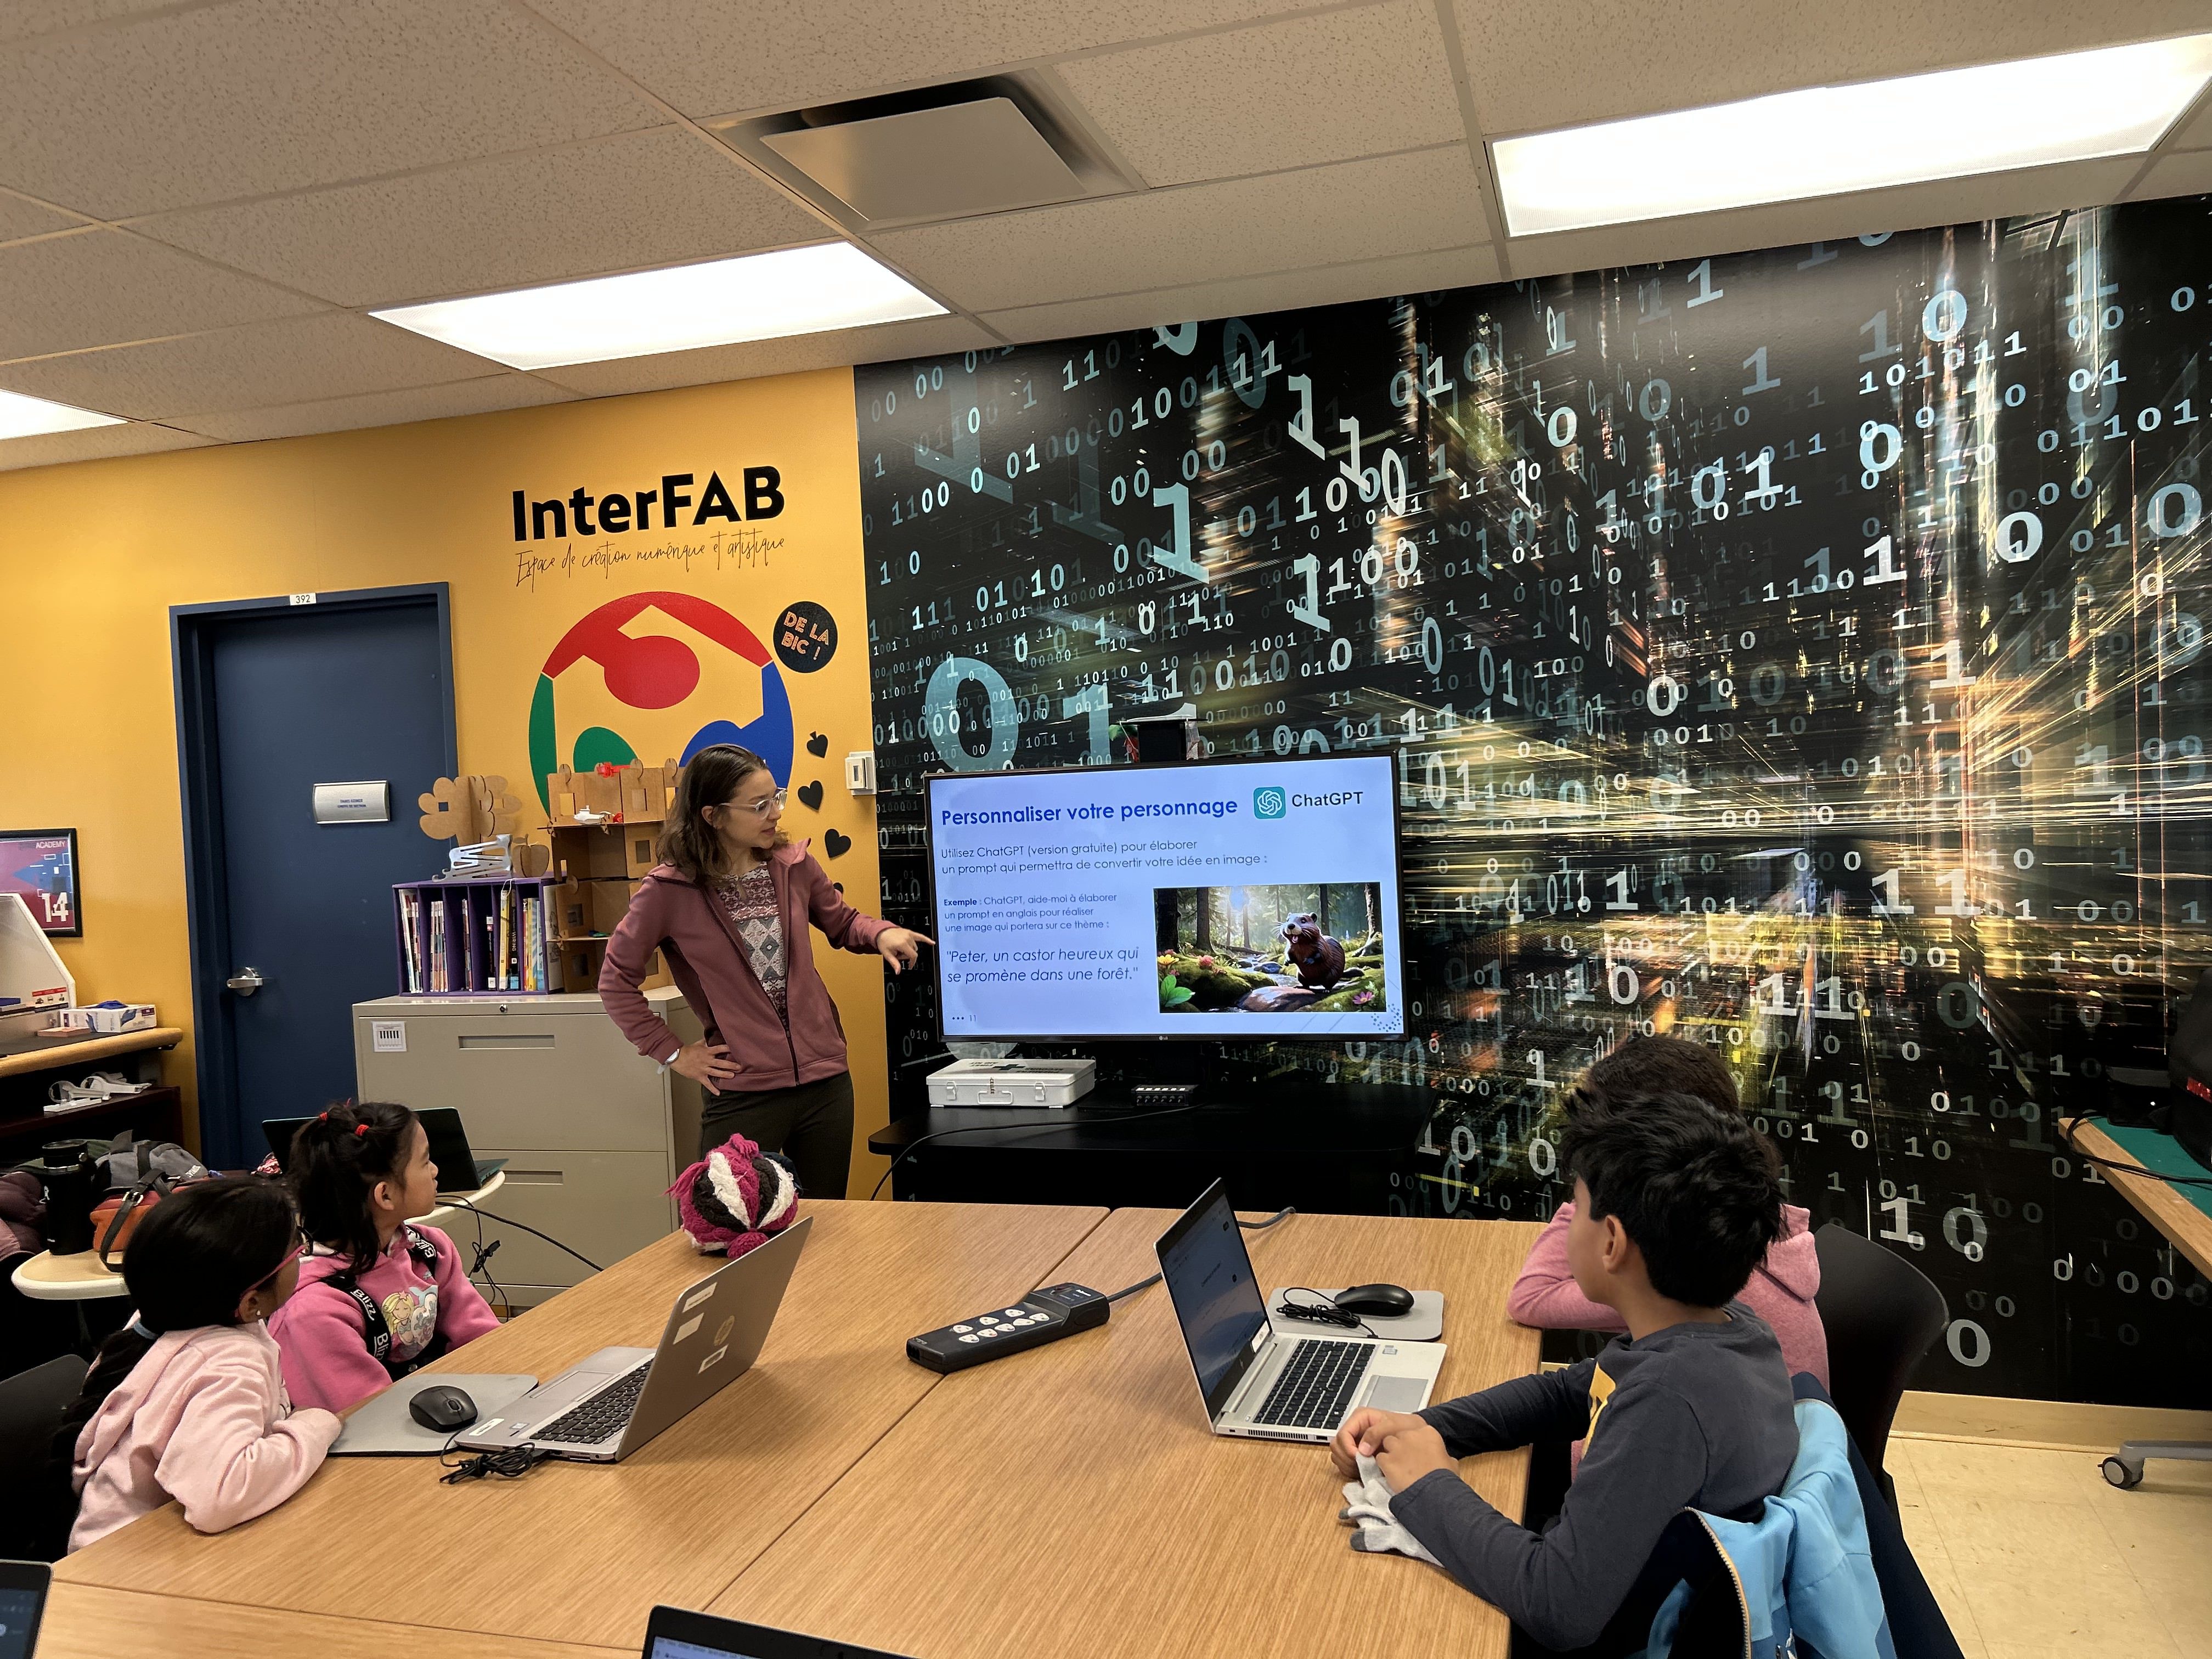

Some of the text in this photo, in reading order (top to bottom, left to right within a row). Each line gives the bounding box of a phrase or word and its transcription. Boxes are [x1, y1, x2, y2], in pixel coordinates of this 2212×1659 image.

[512, 466, 785, 541] InterFAB
[516, 528, 785, 592] Espace de création numérique et artistique
[296, 594, 311, 604] 392
[783, 611, 829, 646] DE LA
[781, 631, 809, 654] BIC
[1291, 791, 1364, 808] ChatGPT
[942, 805, 1062, 825] Personnaliser
[1067, 803, 1114, 820] votre
[1121, 801, 1238, 821] personnage
[36, 840, 66, 849] ACADEMY
[941, 840, 1198, 858] Utilisez ChatGPT (version gratuite) pour élaborer
[942, 865, 955, 874] un
[958, 863, 997, 875] prompt
[1000, 862, 1016, 874] qui
[1019, 860, 1073, 873] permettra
[1076, 860, 1091, 870] de
[1094, 857, 1142, 868] convertir
[1145, 856, 1173, 867] votre
[1177, 855, 1202, 866] idée
[1205, 856, 1220, 865] en
[1223, 854, 1260, 866] image
[41, 891, 69, 923] 14
[944, 898, 977, 907] Exemple
[984, 896, 1025, 905] ChatGPT,
[1028, 894, 1068, 904] aide-moi
[1070, 894, 1076, 902] à
[1079, 893, 1117, 902] élaborer
[958, 910, 990, 920] prompt
[1006, 909, 1037, 918] anglais
[1040, 910, 1060, 918] pour
[1062, 907, 1093, 916] réaliser
[964, 924, 992, 933] image
[995, 922, 1008, 933] qui
[1011, 922, 1043, 932] portera
[1075, 920, 1104, 929] thème
[946, 946, 1139, 963] "Peter, un castor heureux qui
[947, 967, 1138, 984] se promène dans une forêt."
[353, 1289, 376, 1315] Blizz
